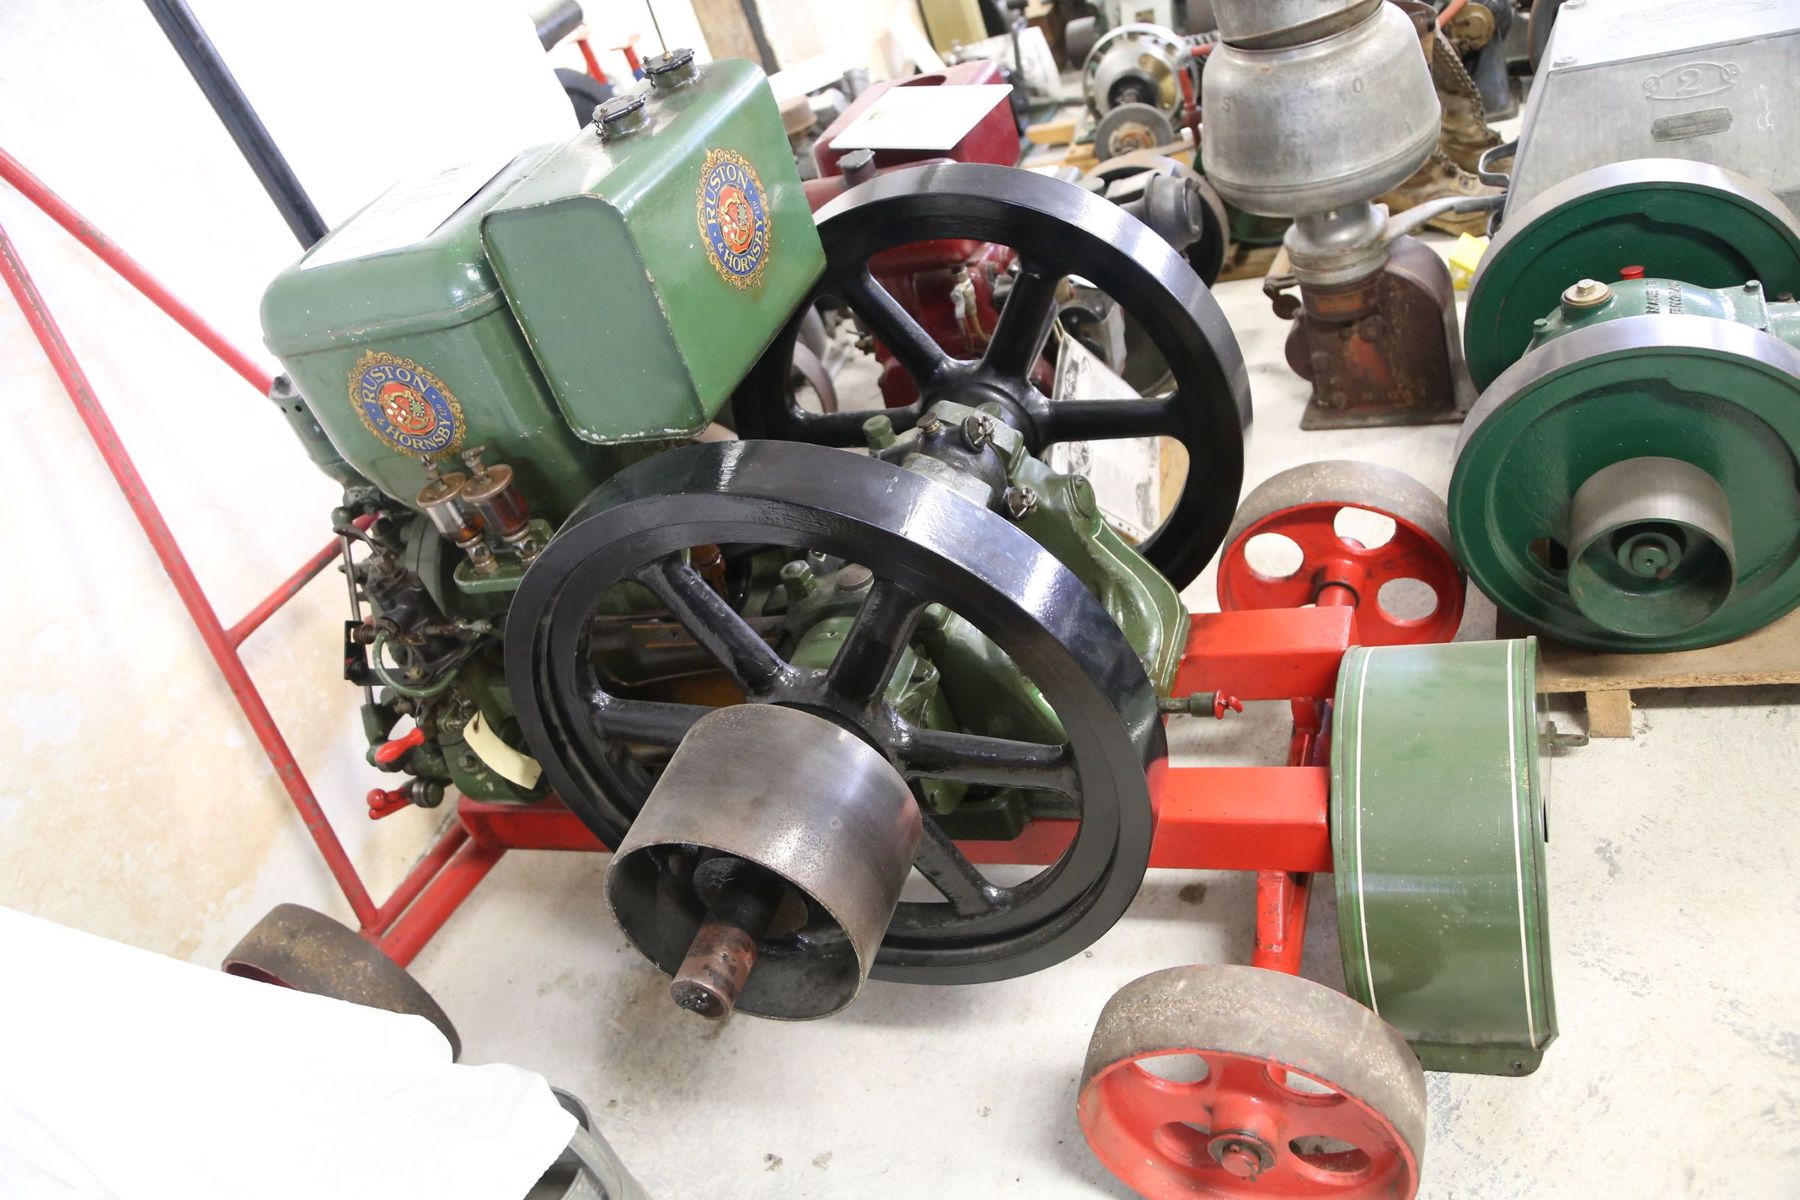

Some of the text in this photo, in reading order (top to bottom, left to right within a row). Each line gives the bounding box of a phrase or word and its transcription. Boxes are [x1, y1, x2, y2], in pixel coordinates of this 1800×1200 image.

[707, 164, 749, 224] RUSTON
[718, 242, 724, 254] &
[723, 215, 765, 273] HORNSBY
[362, 365, 431, 403] RUSTON
[385, 418, 451, 450] HORNSBY
